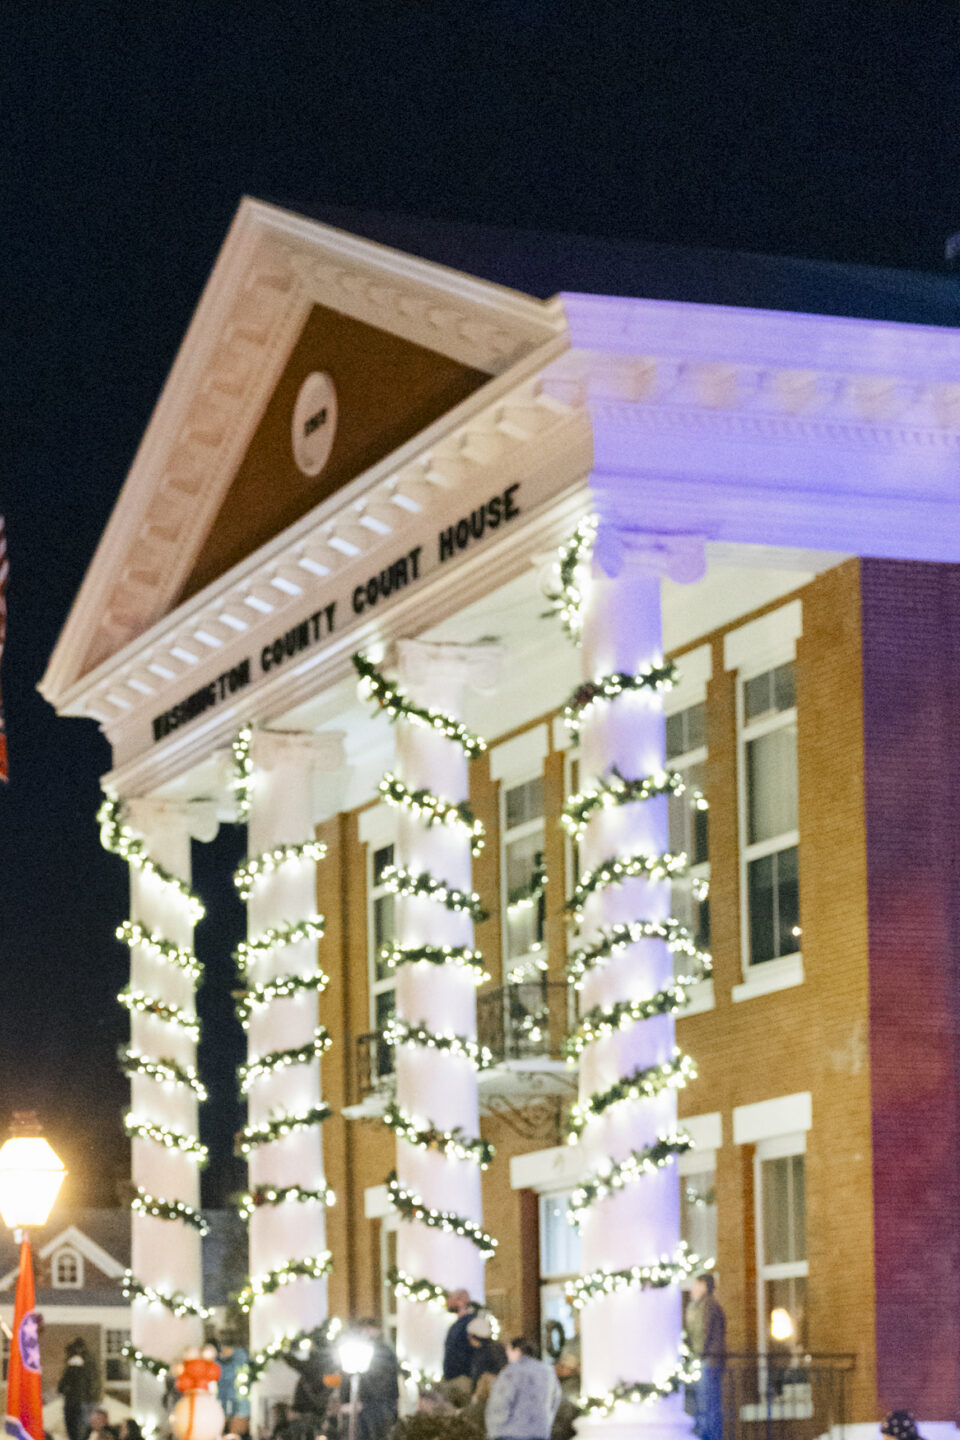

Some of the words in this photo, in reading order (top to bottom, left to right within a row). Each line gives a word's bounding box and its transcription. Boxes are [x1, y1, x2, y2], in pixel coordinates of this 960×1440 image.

[261, 602, 337, 672] COUNTY
[352, 545, 422, 614] COURT
[439, 482, 521, 563] HOUSE
